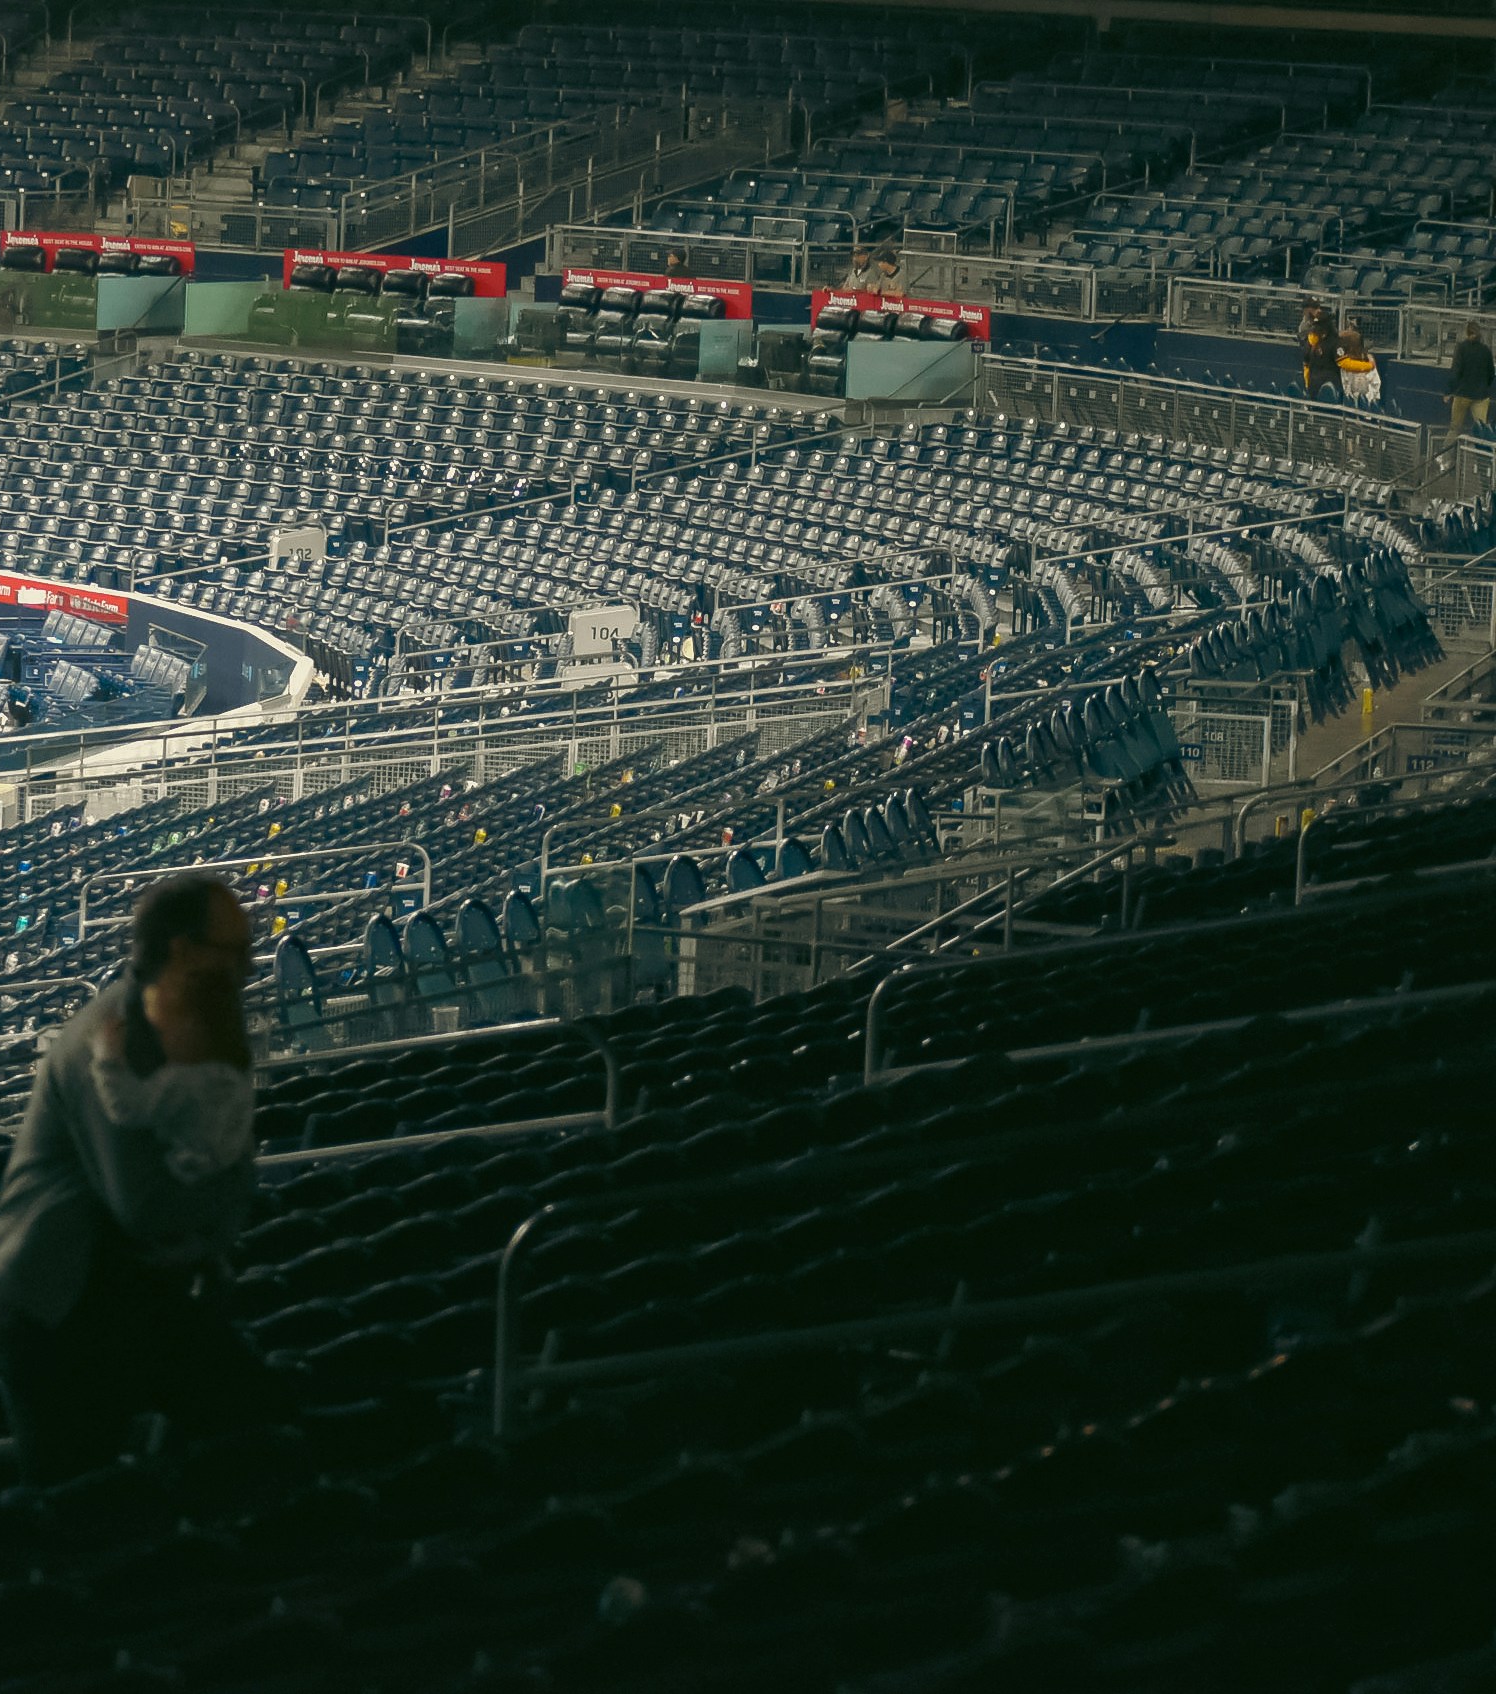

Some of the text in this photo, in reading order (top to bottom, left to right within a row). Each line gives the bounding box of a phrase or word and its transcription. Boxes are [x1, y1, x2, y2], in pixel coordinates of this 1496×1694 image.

[5, 232, 39, 245] Jerome's
[100, 237, 131, 250] Jerome's
[292, 250, 324, 264] Jerome's
[409, 258, 441, 272] Jerome's
[566, 269, 594, 284] Jerome's
[666, 279, 695, 293] Jerome's
[828, 292, 857, 307] Jerome's
[880, 297, 904, 312] Jerome's
[959, 305, 983, 321] Jerome's
[1204, 731, 1224, 742] 108
[1179, 746, 1200, 758] 110
[1411, 758, 1434, 771] 112
